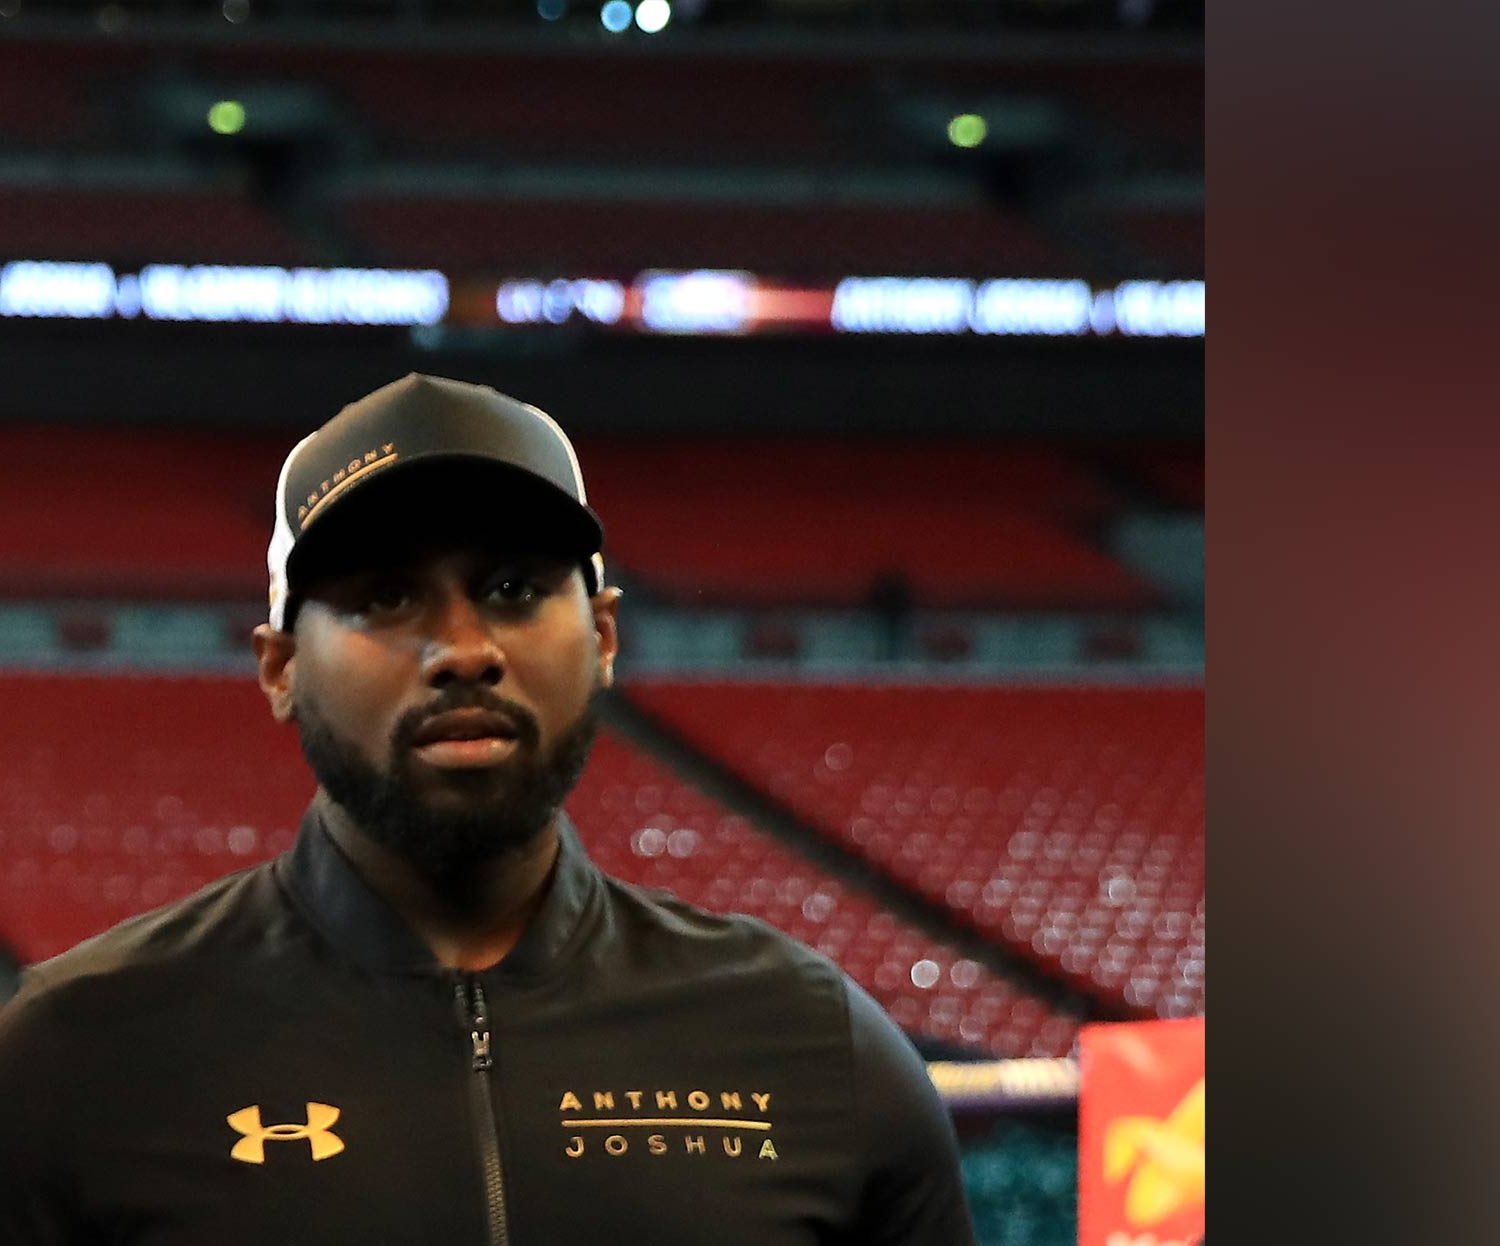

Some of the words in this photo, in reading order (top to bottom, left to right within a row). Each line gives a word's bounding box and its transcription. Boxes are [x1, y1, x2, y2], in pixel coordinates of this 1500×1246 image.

[297, 441, 395, 519] ANTHONY
[559, 1090, 771, 1112] ANTHONY
[565, 1134, 779, 1160] JOSHUA
